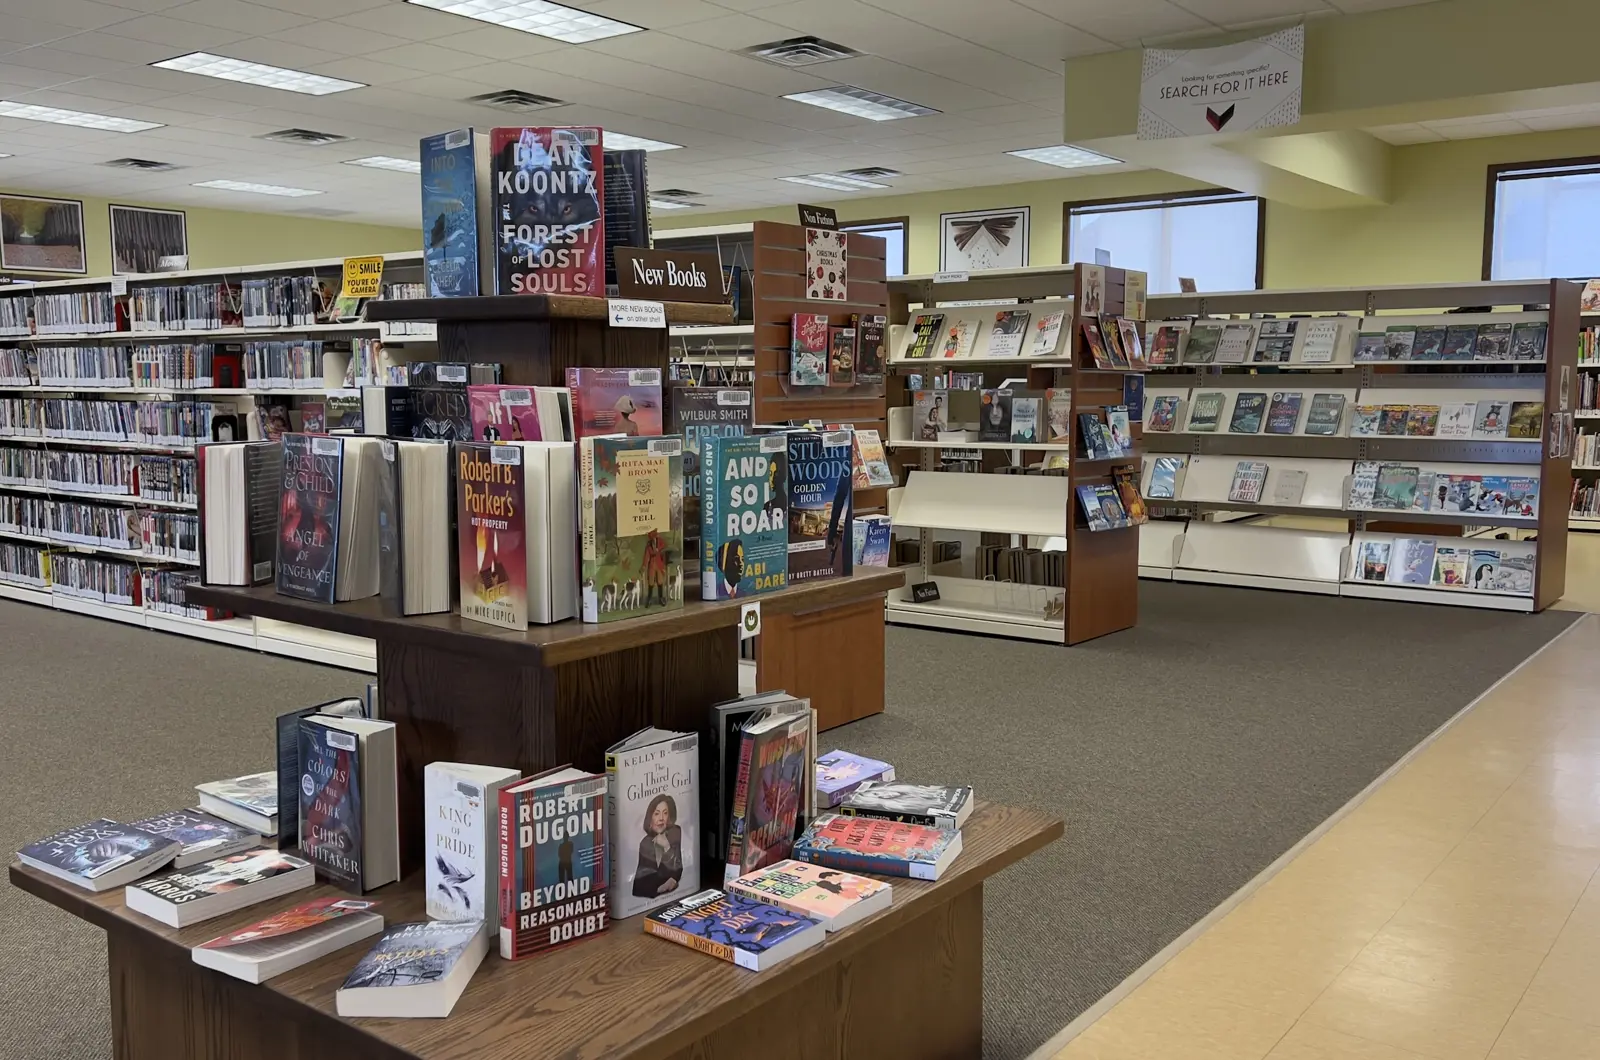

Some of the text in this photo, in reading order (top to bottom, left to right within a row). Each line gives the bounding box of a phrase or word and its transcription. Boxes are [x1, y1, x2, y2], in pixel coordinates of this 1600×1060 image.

[1181, 64, 1270, 83] Looking for something specific?
[1160, 70, 1290, 100] SEARCH FOR IT HERE
[514, 140, 581, 166] DEAN
[431, 154, 456, 173] INTO
[498, 170, 598, 194] KOONTZ
[502, 202, 510, 220] THE
[803, 210, 835, 226] Non Fiction
[502, 224, 594, 245] FOREST
[511, 248, 586, 269] OF LOST
[816, 250, 838, 258] CHRISTMAS
[360, 262, 381, 274] SMILE
[432, 261, 461, 274] CECELIA
[631, 258, 707, 288] New Books
[346, 279, 369, 287] YOU'RE
[350, 286, 376, 294] CAMERA
[510, 272, 587, 294] SOULS
[610, 304, 629, 312] MORE
[410, 392, 468, 418] SECRETS
[680, 409, 748, 421] WILBUR SMITH
[704, 442, 713, 466] AND
[789, 442, 849, 462] STUART
[285, 450, 334, 477] PRESTON
[460, 452, 516, 485] Robert B.
[620, 458, 665, 468] RITA MAE
[628, 468, 660, 477] BROWN
[724, 456, 768, 481] AND
[788, 460, 851, 482] WOODS
[284, 472, 335, 494] & CHILD
[705, 469, 713, 484] SO
[730, 482, 770, 508] SO I
[794, 482, 827, 494] GOLDEN
[800, 492, 822, 504] HOUR
[464, 484, 514, 518] Parker's
[632, 498, 654, 506] TIME
[706, 494, 714, 525] ROAR
[471, 517, 508, 530] HOT PROPERTY
[632, 514, 656, 523] TELL
[727, 508, 784, 536] ROAR
[286, 527, 325, 548] ANGEL
[868, 526, 886, 536] Karen
[870, 536, 885, 546] Swan
[298, 550, 309, 562] OF
[705, 540, 714, 562] ABI
[276, 560, 331, 584] VENGEANCE
[745, 562, 766, 578] ABI
[756, 570, 786, 590] DARÉ
[788, 568, 834, 580] BY BRETT BATTLES
[474, 604, 490, 618] MIKE
[492, 608, 516, 624] LUPICA
[326, 748, 337, 760] THE
[624, 752, 656, 768] KELLY
[307, 759, 346, 783] COLORS
[644, 767, 669, 786] Third
[654, 763, 664, 772] The
[326, 786, 338, 798] THE
[627, 769, 692, 802] Gilmore Girl
[314, 800, 341, 820] DARK
[439, 804, 472, 828] KING
[519, 797, 588, 824] ROBERT
[312, 826, 345, 849] CHRIS
[451, 826, 460, 835] OF
[519, 808, 602, 849] DUGONI
[436, 833, 476, 860] PRIDE
[500, 806, 508, 878] ROBERT DUGONI
[302, 840, 360, 875] WHITAKER
[520, 876, 590, 911] BEYOND
[520, 894, 606, 930] REASONABLE
[658, 903, 684, 922] JOHN
[681, 898, 734, 923] NIGHT
[718, 910, 732, 920] &
[720, 911, 760, 930] DAY
[380, 928, 474, 942] ARMSTRONG
[550, 912, 606, 946] DOUBT
[693, 936, 736, 961] NIGHT & DA
